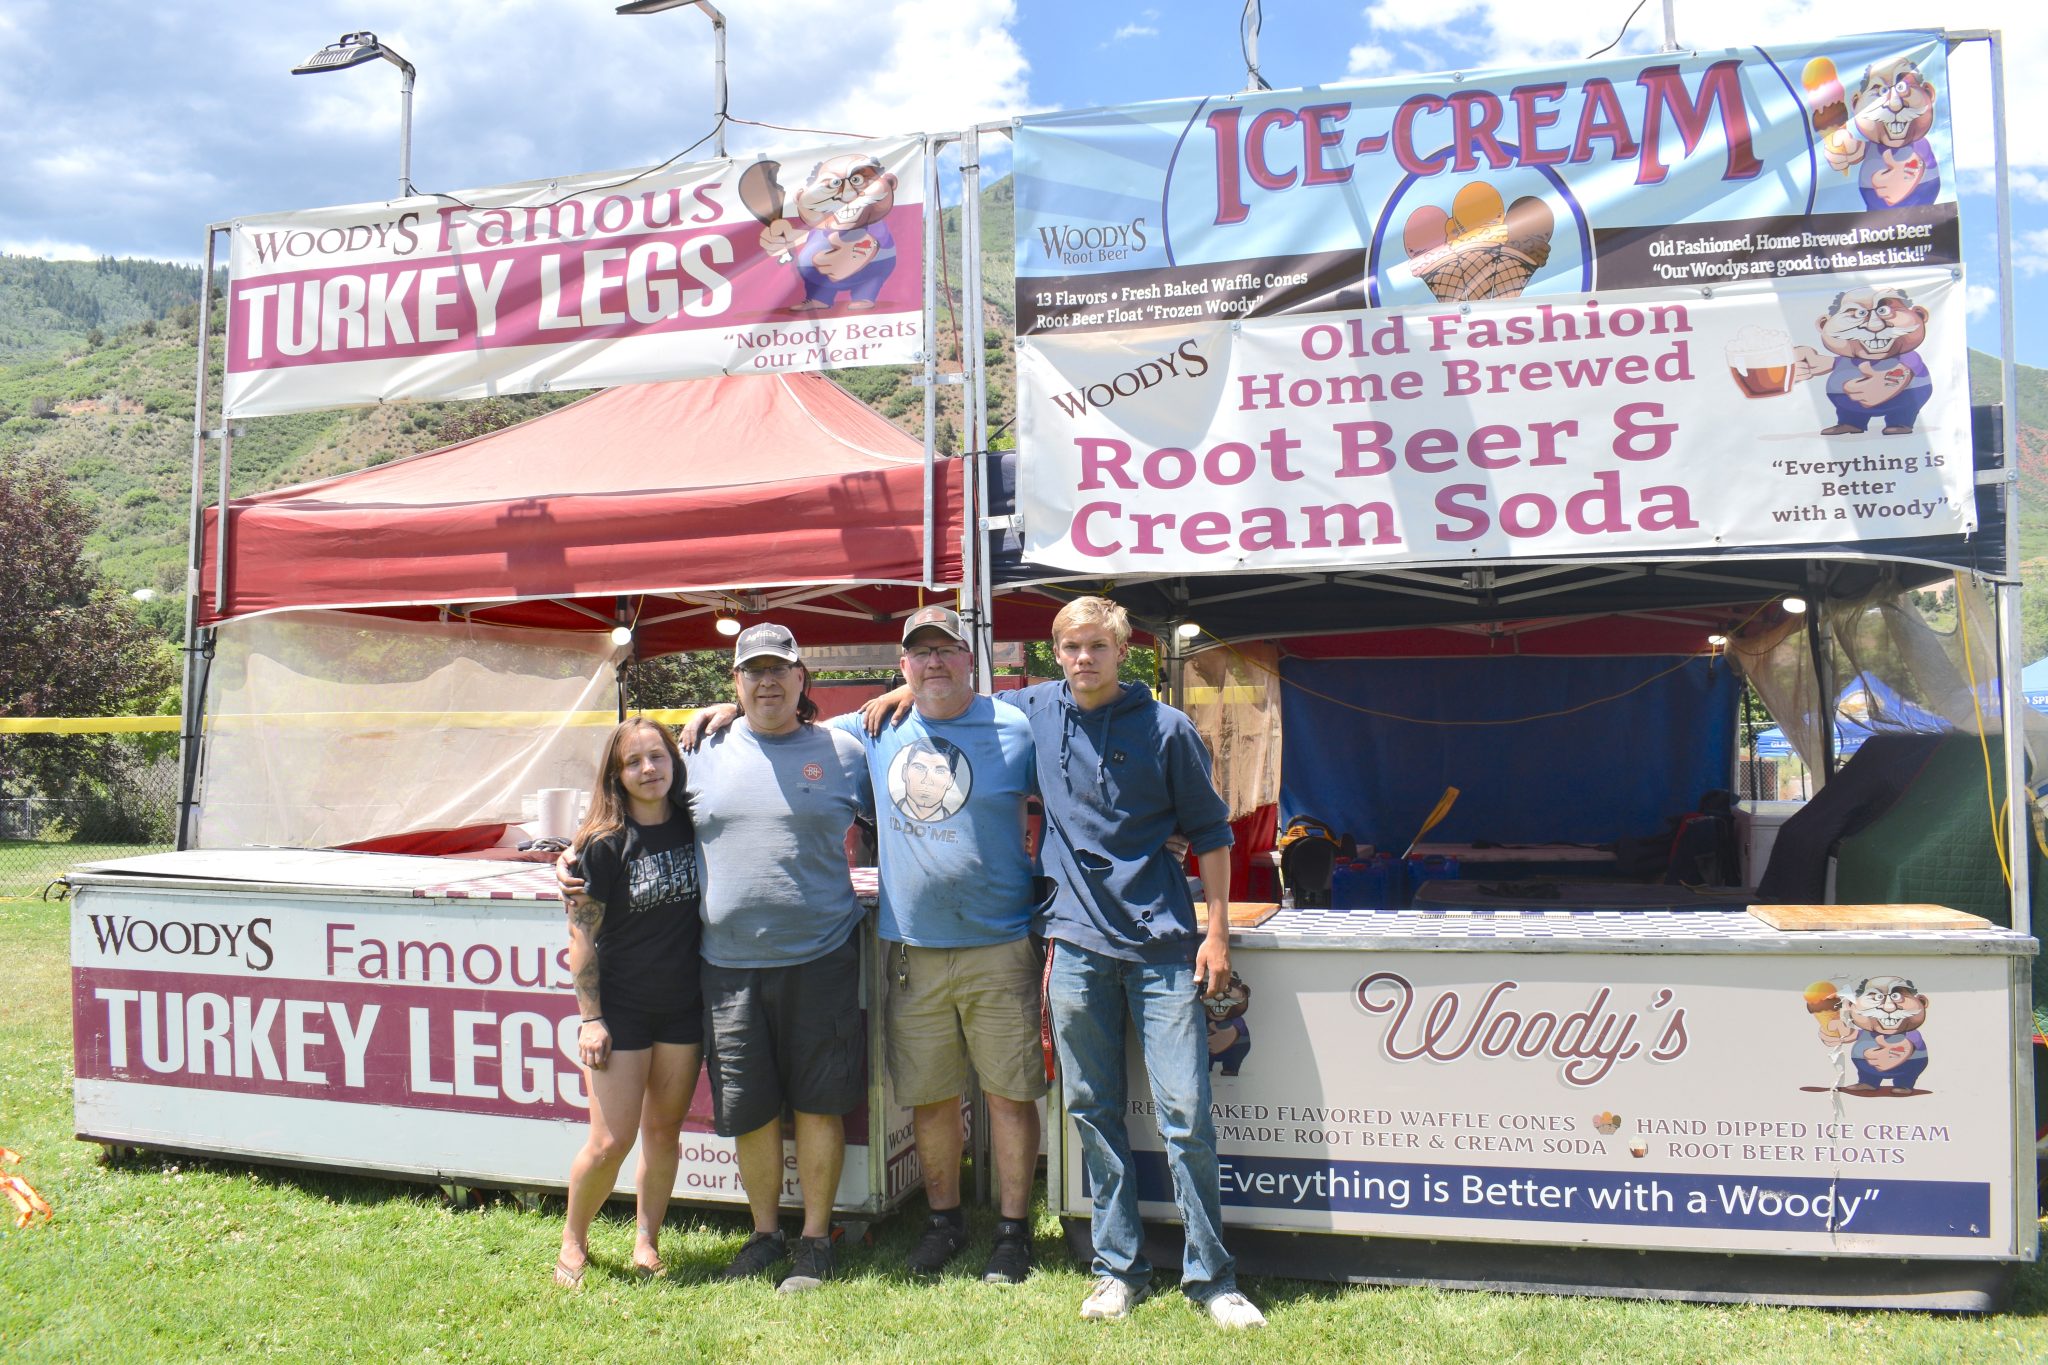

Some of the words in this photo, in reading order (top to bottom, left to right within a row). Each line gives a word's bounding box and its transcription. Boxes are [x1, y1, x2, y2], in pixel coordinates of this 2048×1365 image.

[1204, 57, 1765, 226] ICE-CREAM
[252, 211, 420, 265] WOODYS
[436, 182, 725, 253] Famous
[1038, 217, 1147, 260] WOODYS
[1649, 241, 1675, 257] Old
[1677, 233, 1755, 254] Fashioned,
[1757, 233, 1801, 250] Home
[1802, 228, 1859, 247] Brewed
[1860, 227, 1897, 244] Root
[1897, 222, 1933, 239] Beer
[1063, 250, 1094, 265] Root
[1099, 249, 1129, 262] Beer
[1653, 263, 1690, 280] “Our
[1691, 257, 1750, 280] Woodys
[1750, 259, 1776, 274] are
[1777, 254, 1814, 277] good
[1814, 256, 1831, 271] to
[1831, 251, 1858, 268] the
[1859, 249, 1888, 266] last
[238, 258, 515, 360] TURKEY
[538, 234, 735, 331] LEGS
[1036, 292, 1052, 307] 13
[1055, 290, 1108, 306] Flavors
[1121, 285, 1162, 301] Fresh
[1164, 281, 1209, 298] Baked
[1211, 272, 1261, 293] Waffle
[1264, 271, 1309, 288] Cones
[1036, 313, 1070, 329] Root
[1072, 312, 1103, 327] Beer
[1107, 306, 1144, 324] Float
[1147, 304, 1202, 321] “Frozen
[1206, 295, 1265, 316] Woody”
[1301, 315, 1410, 361] Old
[1428, 299, 1694, 352] Fashion
[722, 325, 838, 351] “Nobody
[846, 319, 918, 342] Beats
[753, 348, 800, 369] our
[804, 341, 884, 365] Meat”
[1050, 338, 1209, 420] WOODYS
[1237, 369, 1423, 412] Home
[1442, 339, 1696, 398] Brewed
[1073, 427, 1306, 492] Root
[1333, 418, 1579, 479] Beer
[1611, 400, 1680, 462] &
[1772, 453, 1919, 478] “Everything
[1925, 451, 1945, 468] is
[1821, 479, 1897, 498] Better
[1070, 498, 1403, 558] Cream
[1433, 469, 1701, 543] Soda
[1772, 504, 1828, 523] with
[1833, 507, 1848, 520] a
[1853, 496, 1950, 519] Woody”
[87, 914, 274, 972] WOODYS
[326, 922, 576, 990] Famous
[94, 987, 382, 1089] TURKEY
[409, 1006, 590, 1109] LEGS
[1356, 971, 1690, 1087] Woody's
[1211, 1103, 1269, 1120] AKED
[1277, 1106, 1393, 1126] FLAVORED
[1400, 1112, 1490, 1130] WAFFLE
[1499, 1114, 1577, 1133] CONES
[1636, 1117, 1708, 1136] HAND
[1716, 1120, 1807, 1139] DIPPED
[1816, 1123, 1856, 1140] ICE
[1863, 1124, 1950, 1142] CREAM
[1294, 1130, 1353, 1146] ROOT
[1362, 1132, 1420, 1149] BEER
[1428, 1134, 1445, 1149] &
[1453, 1135, 1535, 1153] CREAM
[1542, 1138, 1607, 1156] SODA
[1668, 1141, 1734, 1160] ROOT
[1742, 1144, 1806, 1162] BEER
[1814, 1146, 1906, 1165] FLOATS
[686, 1172, 727, 1189] our
[1423, 1172, 1451, 1204] is
[1463, 1175, 1578, 1210] Better
[1587, 1181, 1674, 1213] with
[1686, 1188, 1708, 1216] a
